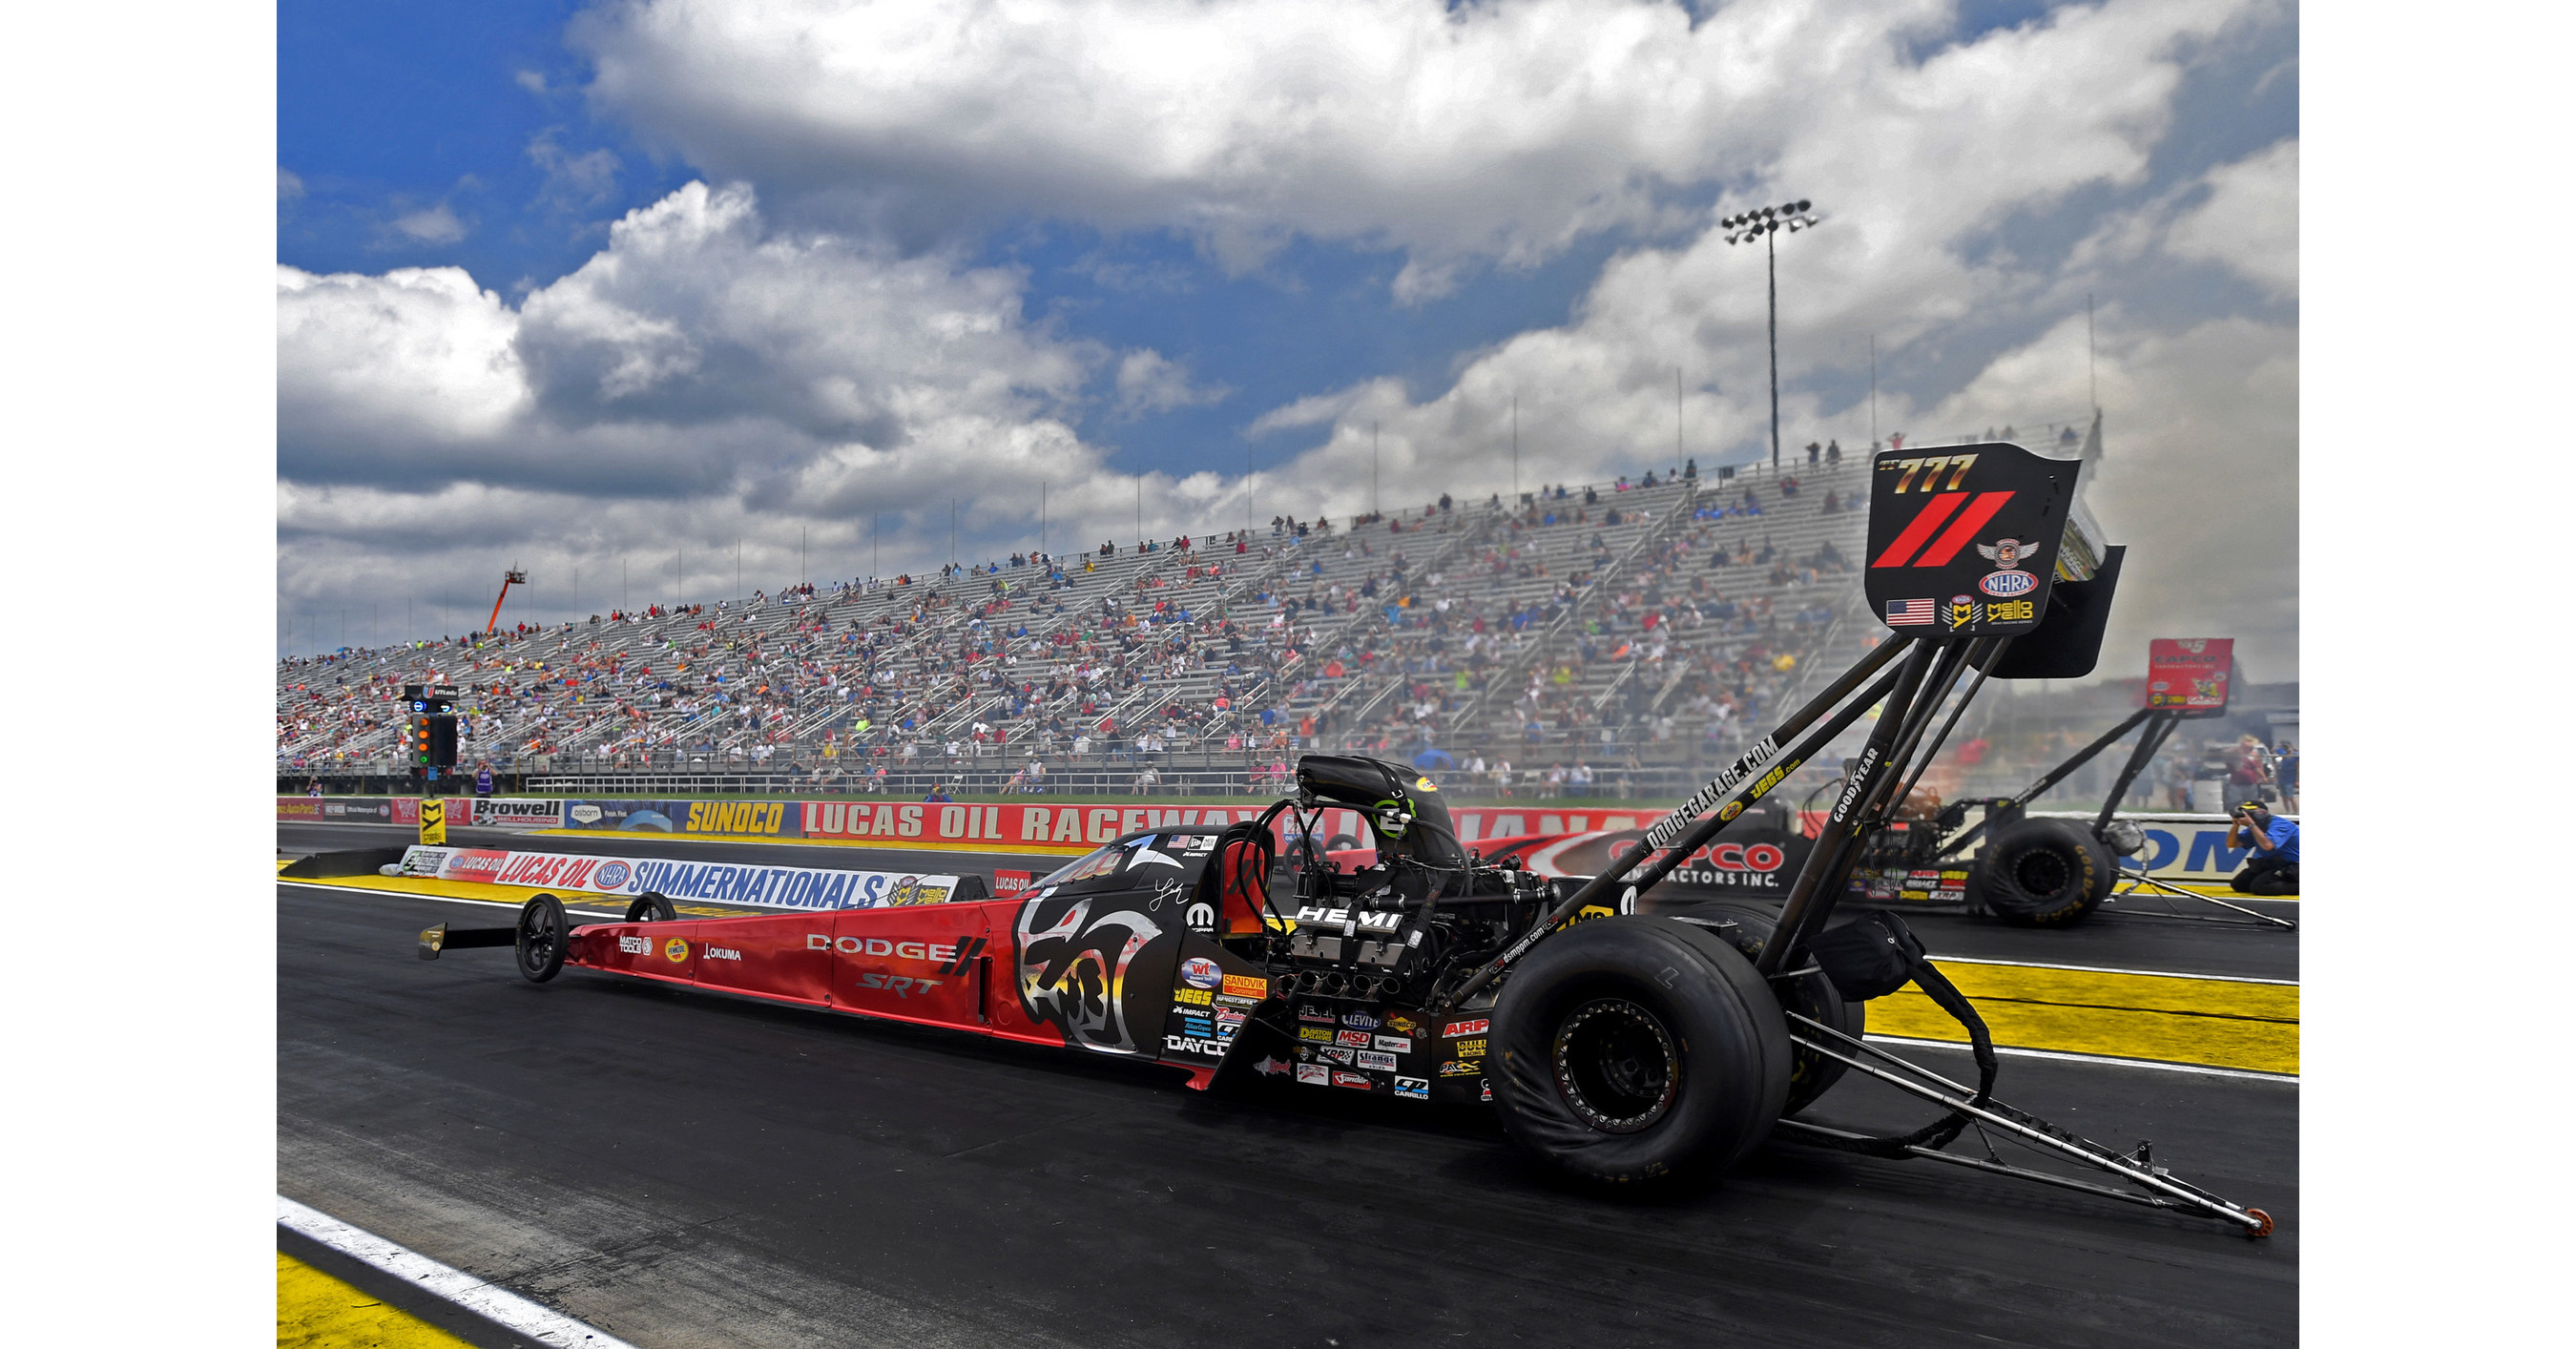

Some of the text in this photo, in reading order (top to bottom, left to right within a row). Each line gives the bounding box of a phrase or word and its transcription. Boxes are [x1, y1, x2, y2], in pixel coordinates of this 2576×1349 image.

[1894, 453, 1980, 494] 777
[1988, 575, 2030, 591] NHRA
[1646, 735, 1779, 851] DODGEGARAGE.COM
[474, 799, 560, 817] Browell
[574, 808, 598, 818] osborn
[496, 816, 558, 824] BELLHOUSING
[686, 801, 785, 834] SUNOCO
[804, 802, 924, 838] LUCAS
[939, 805, 1004, 840] OIL
[463, 856, 490, 870] LUCAS
[488, 858, 504, 872] OIL
[498, 855, 568, 885] LUCAS
[558, 858, 598, 888] OIL
[596, 864, 630, 885] NHRA
[627, 860, 885, 908] SUMMERNATIONALS
[995, 877, 1029, 891] LUCAS OIL
[1742, 873, 1779, 887] INC.
[1296, 905, 1404, 928] HEMI
[619, 935, 642, 945] MATCO
[1503, 925, 1545, 964] dsmppm.com
[619, 944, 642, 954] TOOLS
[709, 946, 741, 962] OKUMA
[806, 933, 958, 964] DODGE
[1192, 962, 1210, 975] wt
[855, 972, 944, 999] SRT
[1224, 975, 1265, 989] SANDVIK
[1174, 988, 1213, 1007] JEGS
[1232, 987, 1257, 996] Coromant
[1183, 1008, 1211, 1018] IMPACT
[1444, 1019, 1489, 1036] ARP
[1339, 1030, 1370, 1043] MSD
[1378, 1038, 1408, 1048] Mastercam
[1459, 1040, 1486, 1051] BULL
[1360, 1051, 1394, 1063] Strange
[1396, 1078, 1427, 1090] CP
[1394, 1090, 1429, 1100] CARRILLO
